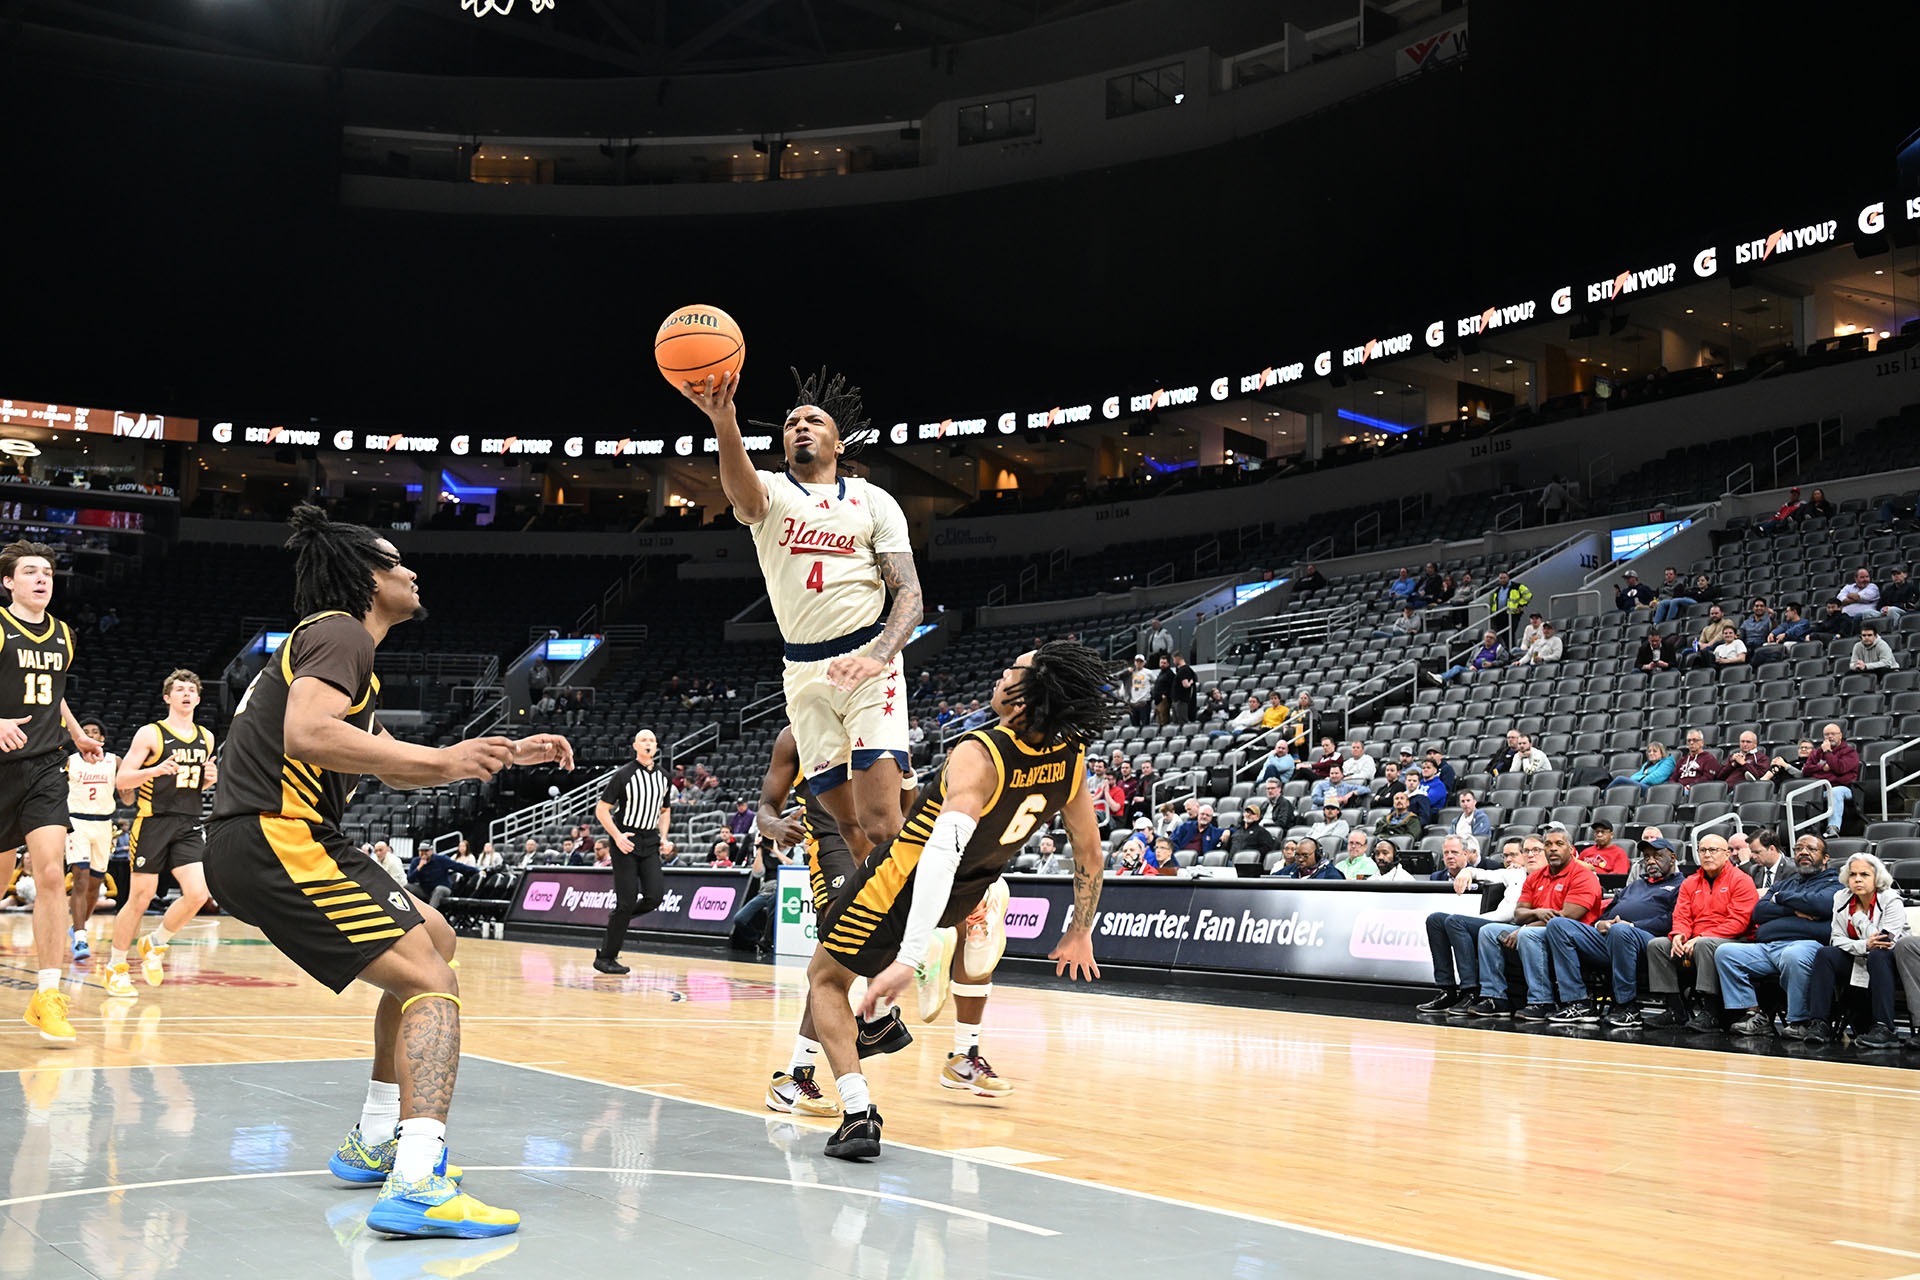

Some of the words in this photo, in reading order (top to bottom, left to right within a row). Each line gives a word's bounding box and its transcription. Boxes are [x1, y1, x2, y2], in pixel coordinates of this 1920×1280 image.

[1858, 202, 1885, 234] G
[1793, 220, 1837, 248] YOU?
[1693, 247, 1717, 277] G
[1638, 262, 1676, 289] YOU?
[1502, 300, 1536, 324] YOU?
[1551, 286, 1571, 314] G
[1383, 333, 1412, 355] YOU?
[1425, 320, 1444, 347] G
[1314, 351, 1331, 376] G
[1876, 361, 1900, 377] 115
[1210, 377, 1228, 401] G
[1102, 396, 1119, 419] G
[212, 423, 232, 443] G
[890, 423, 908, 444] G
[998, 412, 1016, 434] G
[333, 430, 353, 450] G
[450, 435, 470, 455] G
[564, 437, 583, 457] G
[675, 435, 693, 456] G
[778, 517, 855, 549] Flames
[1580, 552, 1599, 570] 115
[806, 561, 824, 593] 4
[17, 648, 63, 671] VALPO
[23, 673, 53, 705] 13
[175, 765, 201, 789] 23
[89, 787, 97, 800] 2
[999, 794, 1047, 846] 6
[561, 886, 584, 911] Pay
[695, 896, 728, 911] Klarna
[1004, 909, 1039, 928] arna
[1100, 909, 1191, 939] smarter.
[1193, 909, 1235, 942] Fan
[1237, 910, 1325, 946] harder.
